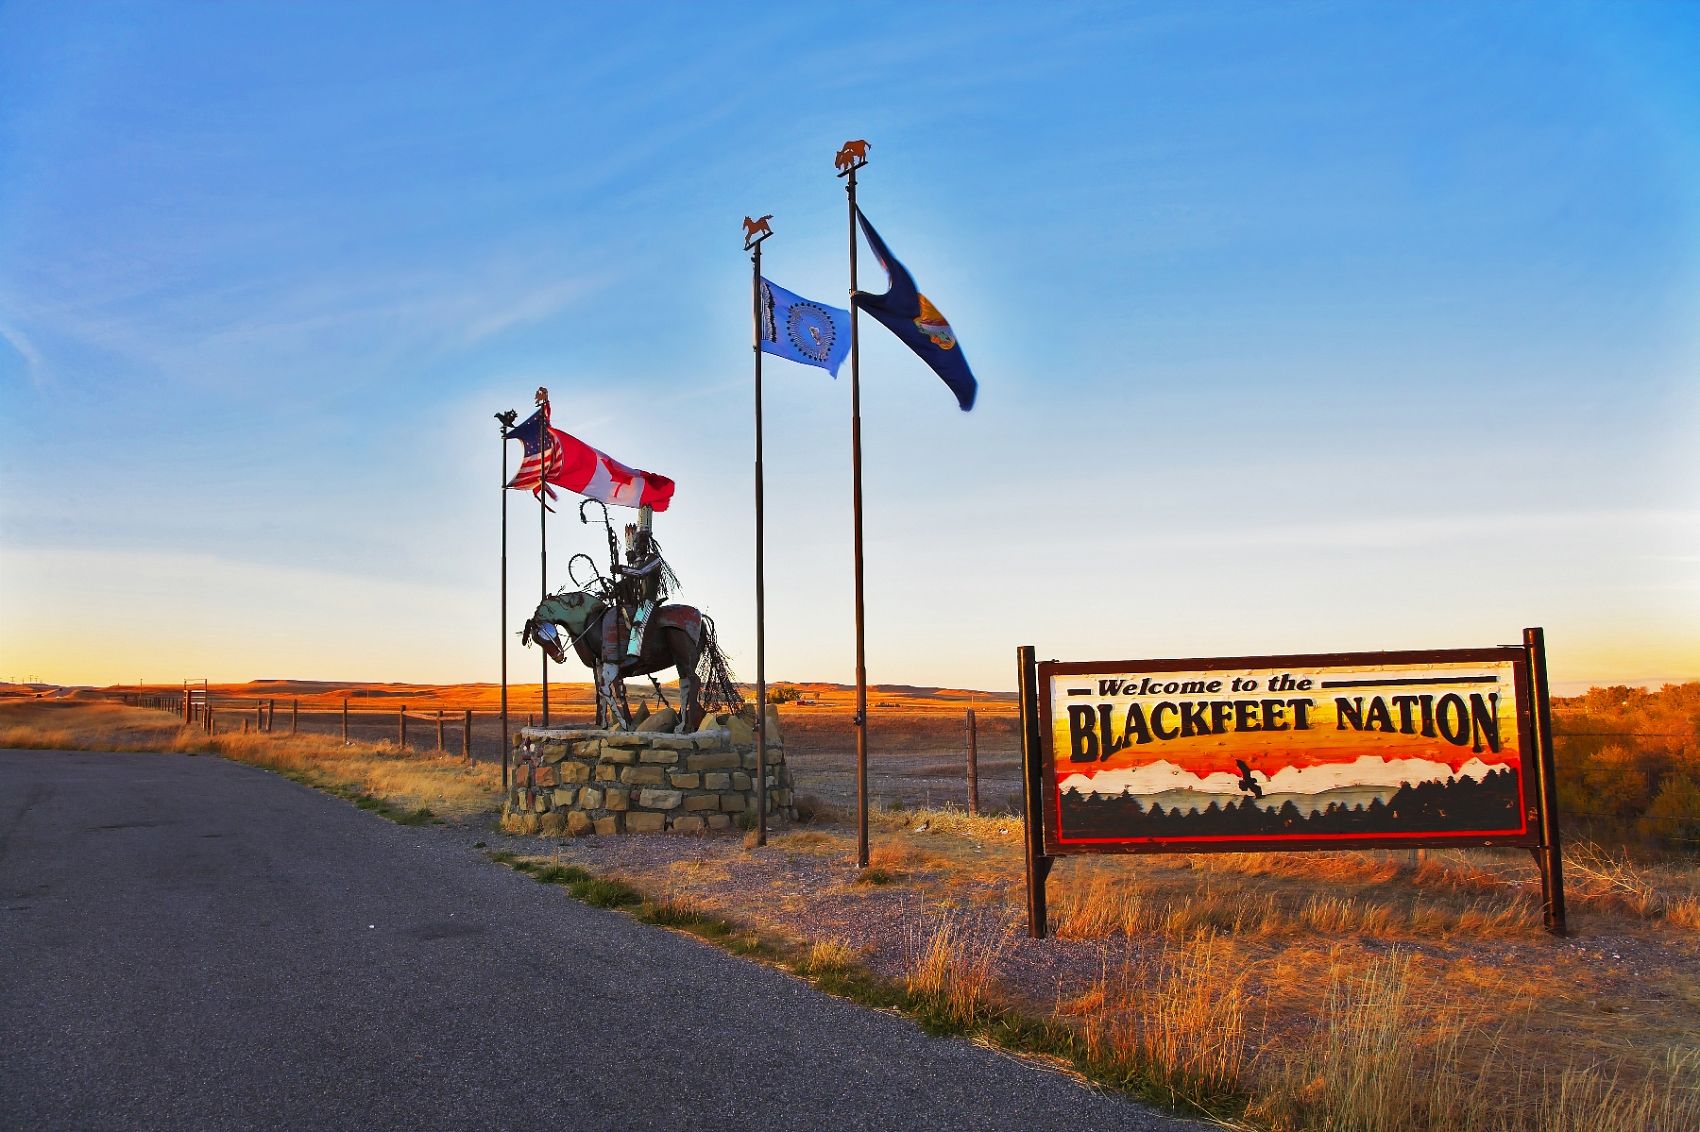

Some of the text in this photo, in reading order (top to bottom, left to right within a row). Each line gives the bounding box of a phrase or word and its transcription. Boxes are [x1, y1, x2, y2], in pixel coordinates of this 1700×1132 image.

[1098, 673, 1313, 696] Welcome to the
[1067, 692, 1500, 763] BLACKFEET NATION
